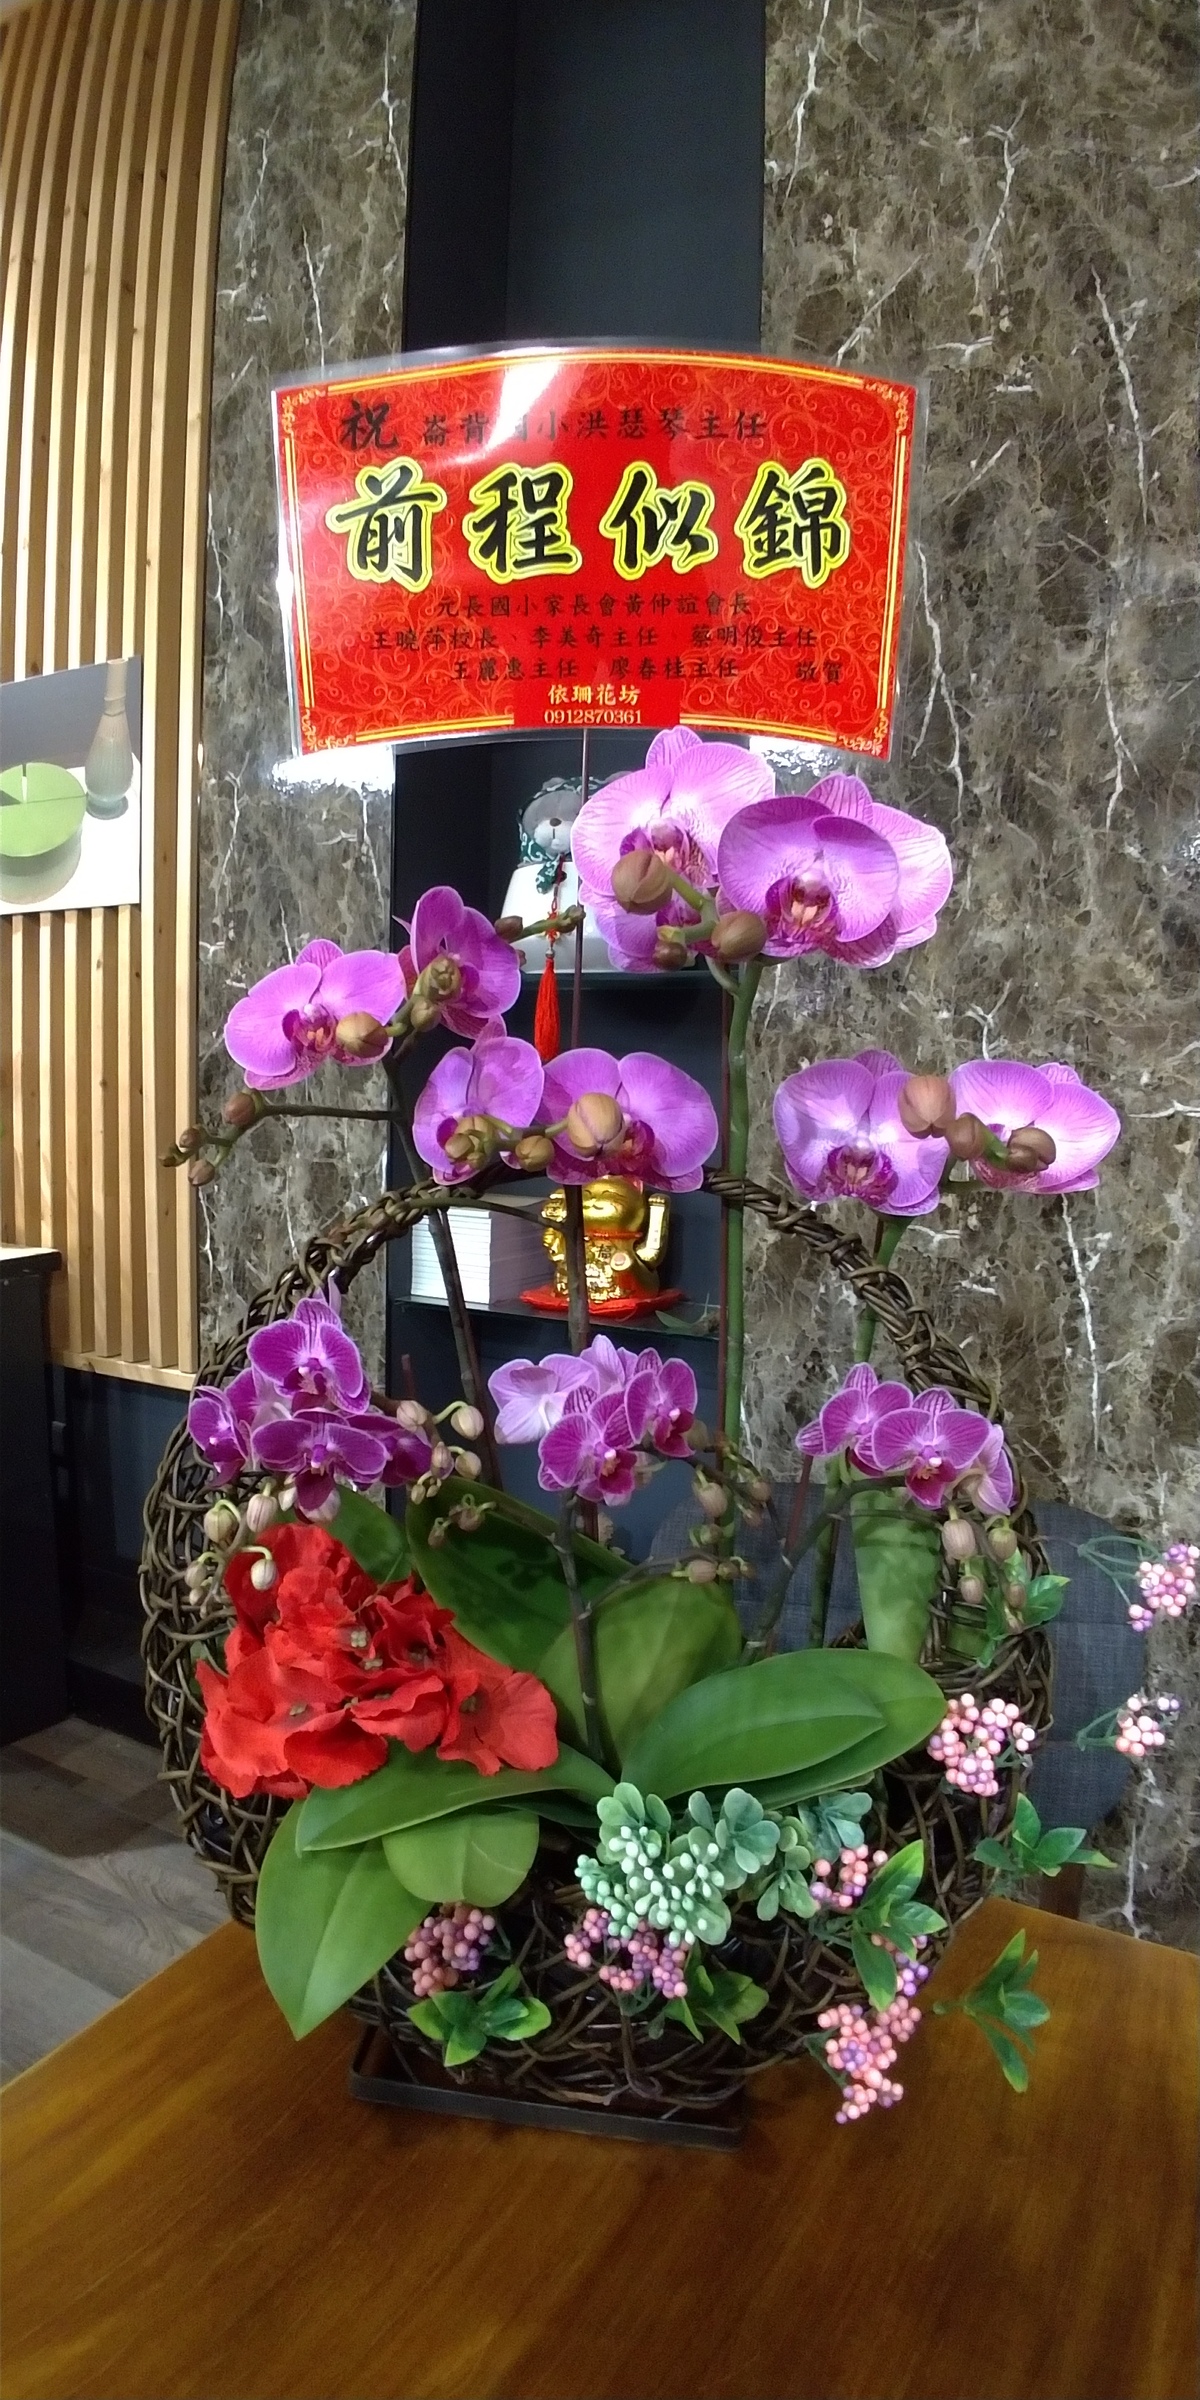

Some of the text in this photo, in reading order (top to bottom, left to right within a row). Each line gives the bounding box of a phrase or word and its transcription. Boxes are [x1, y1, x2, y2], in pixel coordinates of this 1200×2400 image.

[341, 399, 398, 450] 祝
[331, 458, 853, 588] 前程似錦
[796, 661, 843, 685] 敬賀
[547, 683, 641, 706] 依珊花坊
[544, 709, 642, 724] 0912870361
